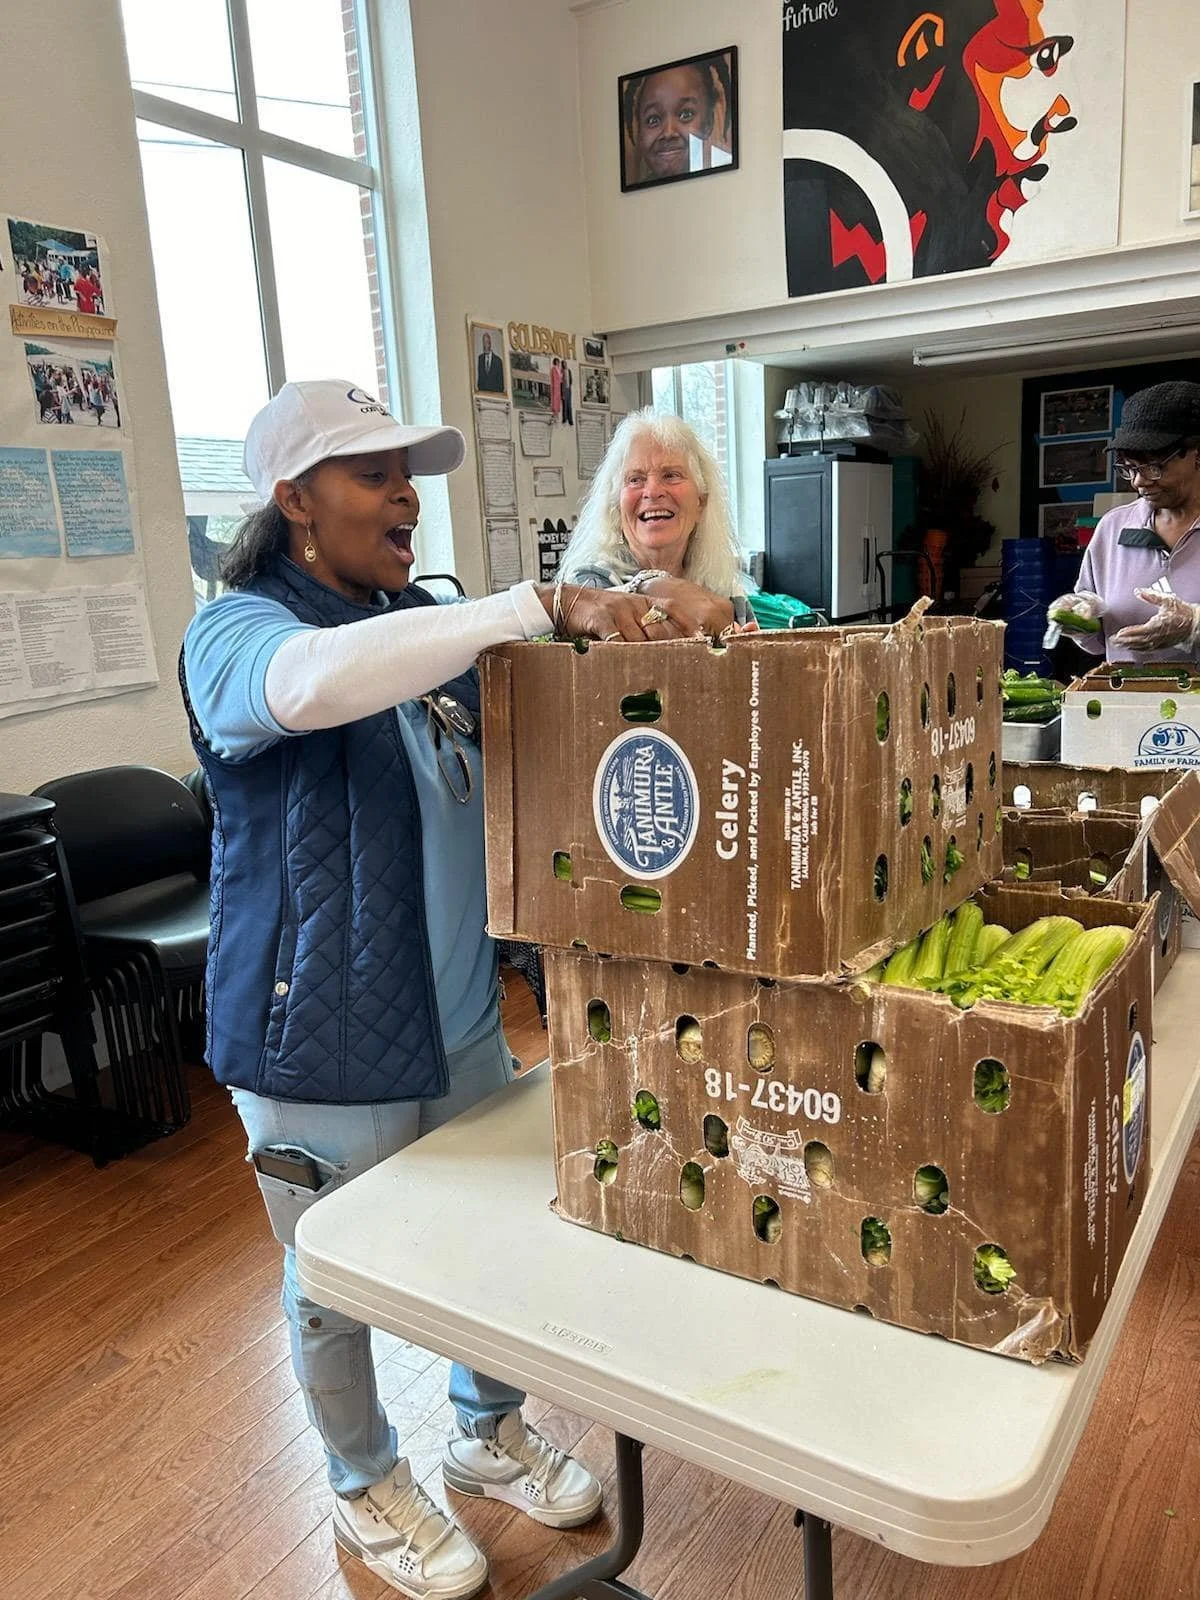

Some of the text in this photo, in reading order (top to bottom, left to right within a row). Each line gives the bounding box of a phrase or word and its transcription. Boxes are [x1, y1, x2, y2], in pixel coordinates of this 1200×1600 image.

[508, 321, 577, 360] GOLDSMITH
[931, 716, 975, 757] 60437-18
[1134, 757, 1166, 767] FAMILY
[628, 744, 664, 867] TANIMURA
[654, 764, 685, 849] & ANTLE
[716, 758, 745, 860] Celery
[746, 660, 762, 961] Planted, Picked, and Packed by Employee Owners
[791, 738, 803, 890] TANIMURA & ANTLE, INC.
[704, 1068, 841, 1124] 60437-18
[1110, 1094, 1120, 1192] Celery
